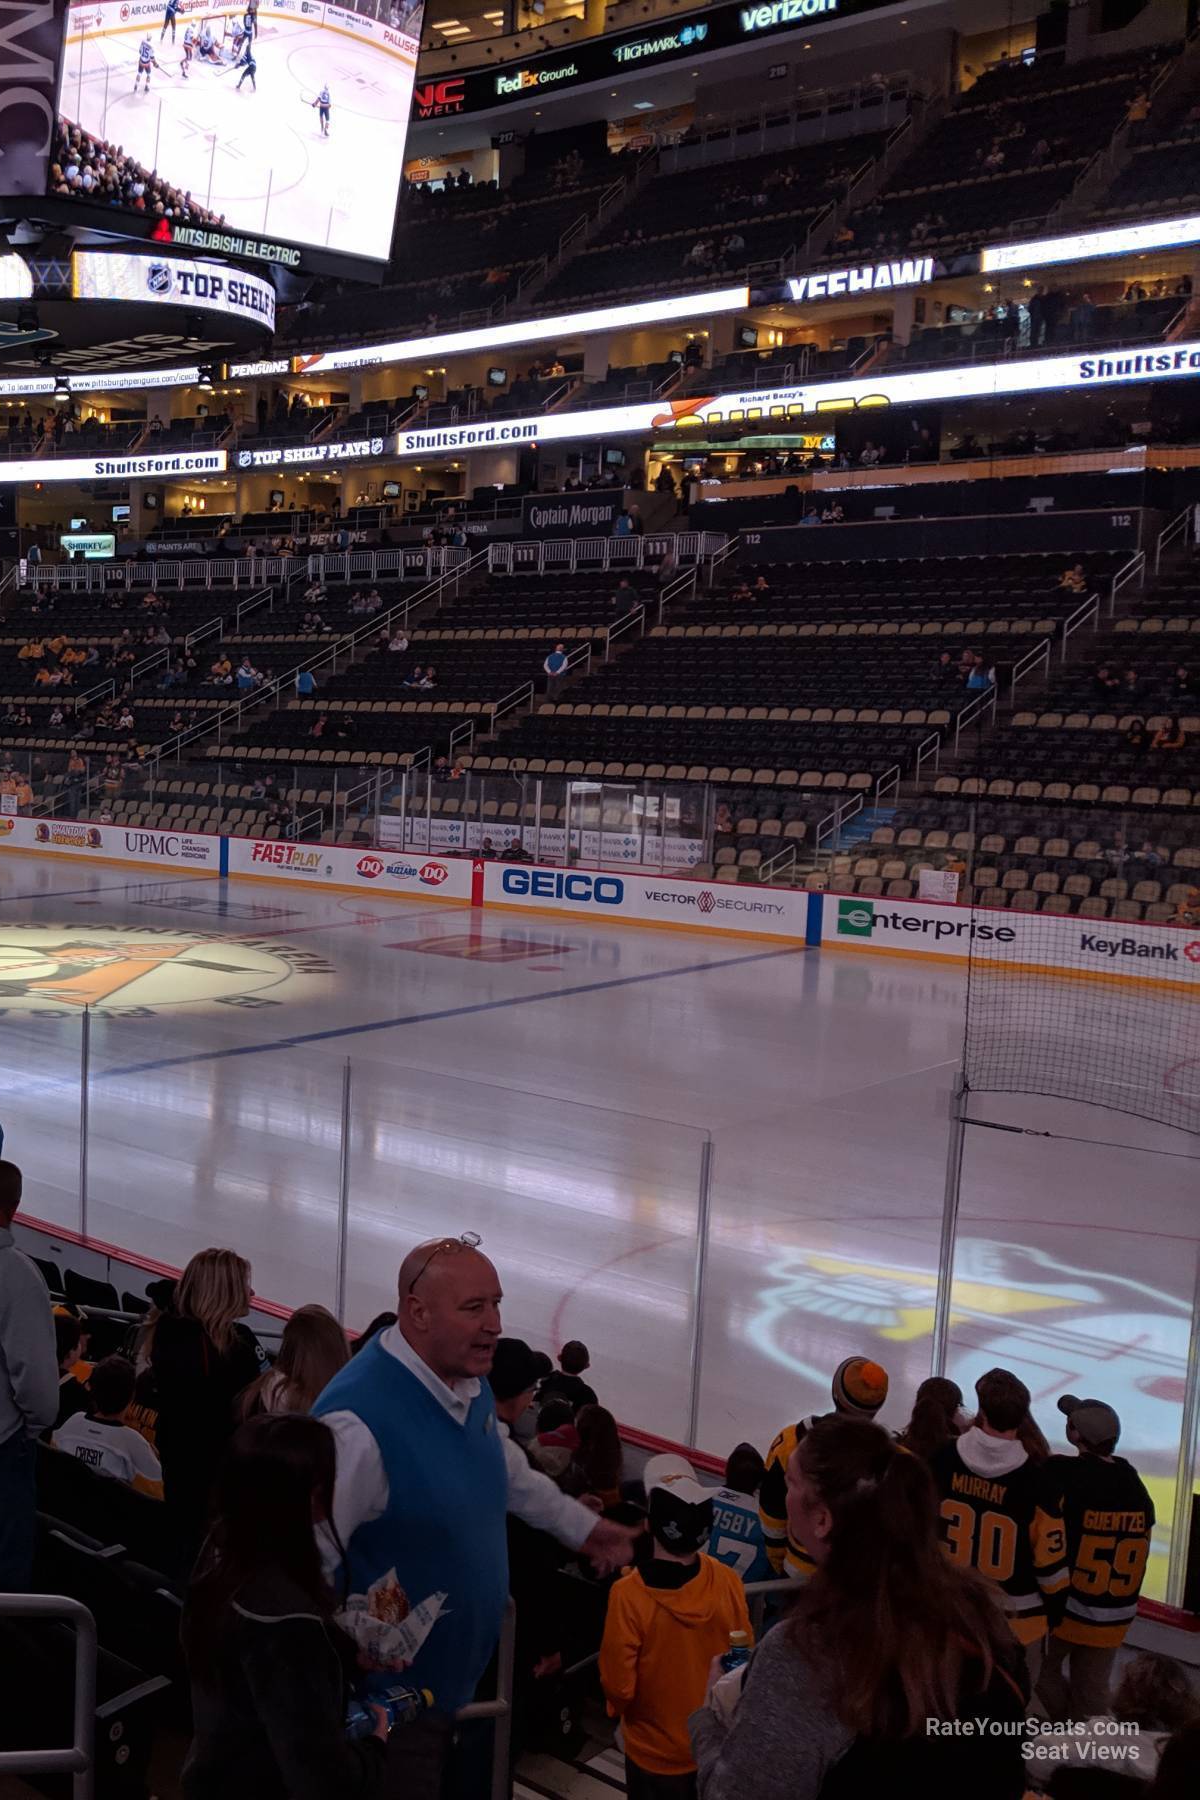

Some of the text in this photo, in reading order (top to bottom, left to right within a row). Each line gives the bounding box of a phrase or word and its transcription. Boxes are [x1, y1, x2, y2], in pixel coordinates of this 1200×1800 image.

[741, 0, 838, 31] verizon
[613, 35, 681, 63] HIGHMARK
[497, 70, 539, 95] FedEx
[174, 226, 301, 265] MITSUBISHI ELECTRIC
[177, 271, 223, 299] TOP
[228, 281, 270, 315] SHELF
[230, 361, 289, 378] PENGUINS
[405, 422, 538, 450] ShultsFord.com
[252, 440, 371, 465] TOP SHELF PLAYS
[95, 455, 219, 475] ShultsFord.com
[529, 503, 613, 529] Captain Morgan
[1111, 514, 1131, 526] 112
[647, 542, 668, 555] 111
[745, 534, 761, 545] 112
[405, 554, 424, 568] 110
[516, 548, 535, 561] 111
[106, 569, 123, 580] 110
[124, 831, 179, 857] UPMC
[181, 844, 210, 854] CHANGING
[181, 851, 207, 861] MEDICINE
[251, 842, 296, 865] FAST
[291, 853, 323, 868] PLAY
[359, 859, 379, 875] DQ
[386, 865, 418, 877] BLIZZARD
[422, 865, 444, 882] DQ
[502, 868, 624, 905] GEICO
[644, 890, 697, 906] VECTOR
[846, 908, 1017, 943] enterprise
[1079, 933, 1180, 962] KeyBank
[73, 1447, 103, 1467] CROSBY
[951, 1472, 1008, 1506] MURRAY
[713, 1508, 757, 1537] OSBY
[1082, 1508, 1146, 1533] GUENTZE
[940, 1499, 1019, 1582] 30
[1047, 1529, 1064, 1553] 3
[1071, 1535, 1150, 1598] 59
